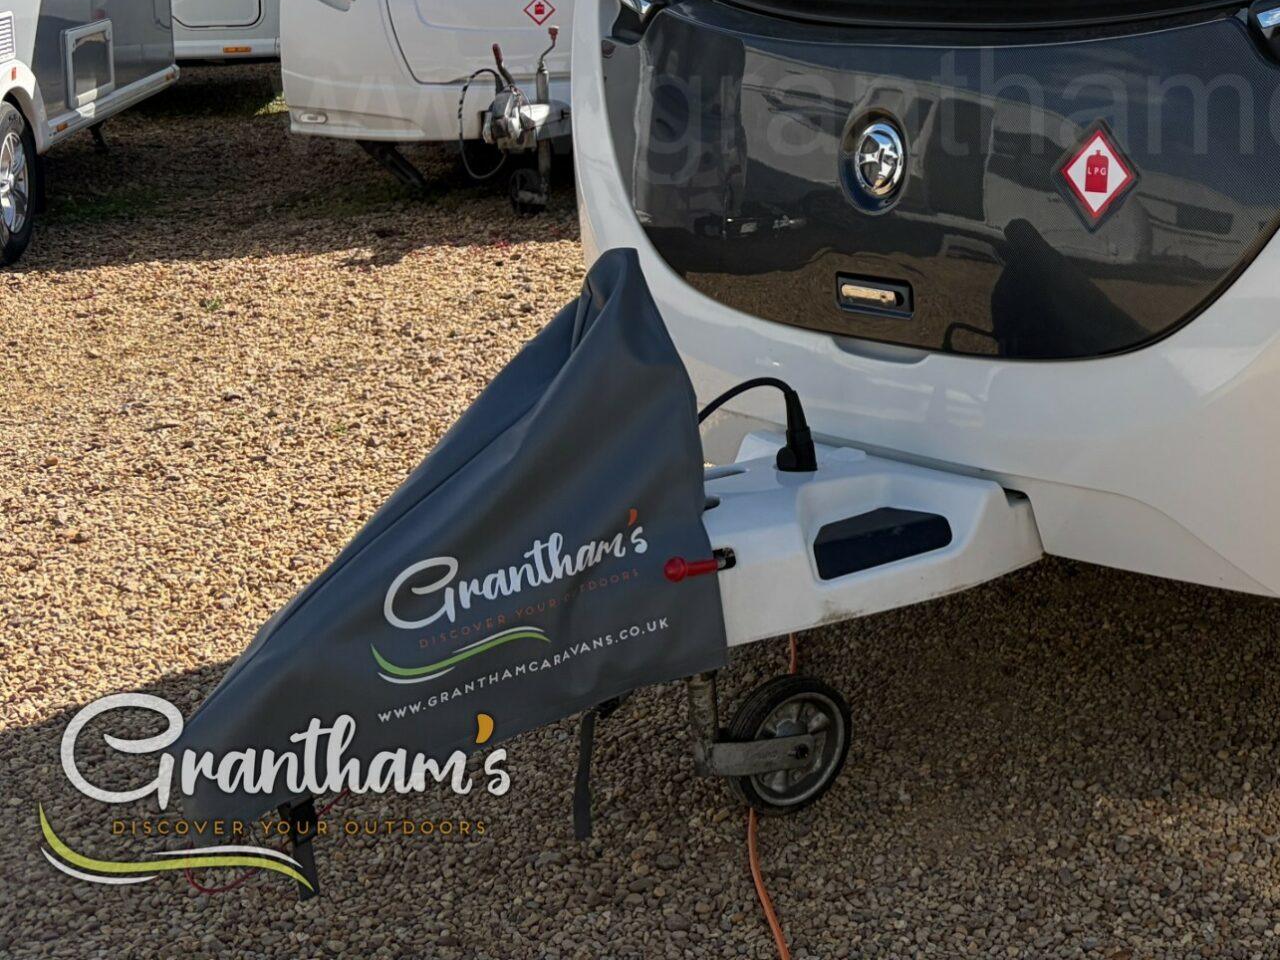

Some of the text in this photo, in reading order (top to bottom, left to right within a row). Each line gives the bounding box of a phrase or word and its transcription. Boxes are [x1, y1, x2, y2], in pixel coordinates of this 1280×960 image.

[1088, 167, 1107, 176] LPG
[383, 508, 648, 630] Grantham's
[419, 569, 639, 648] DISCOVER YOUR TDOORS
[377, 617, 669, 723] WWW.GRANTHAMCARAVANS.CO.UK
